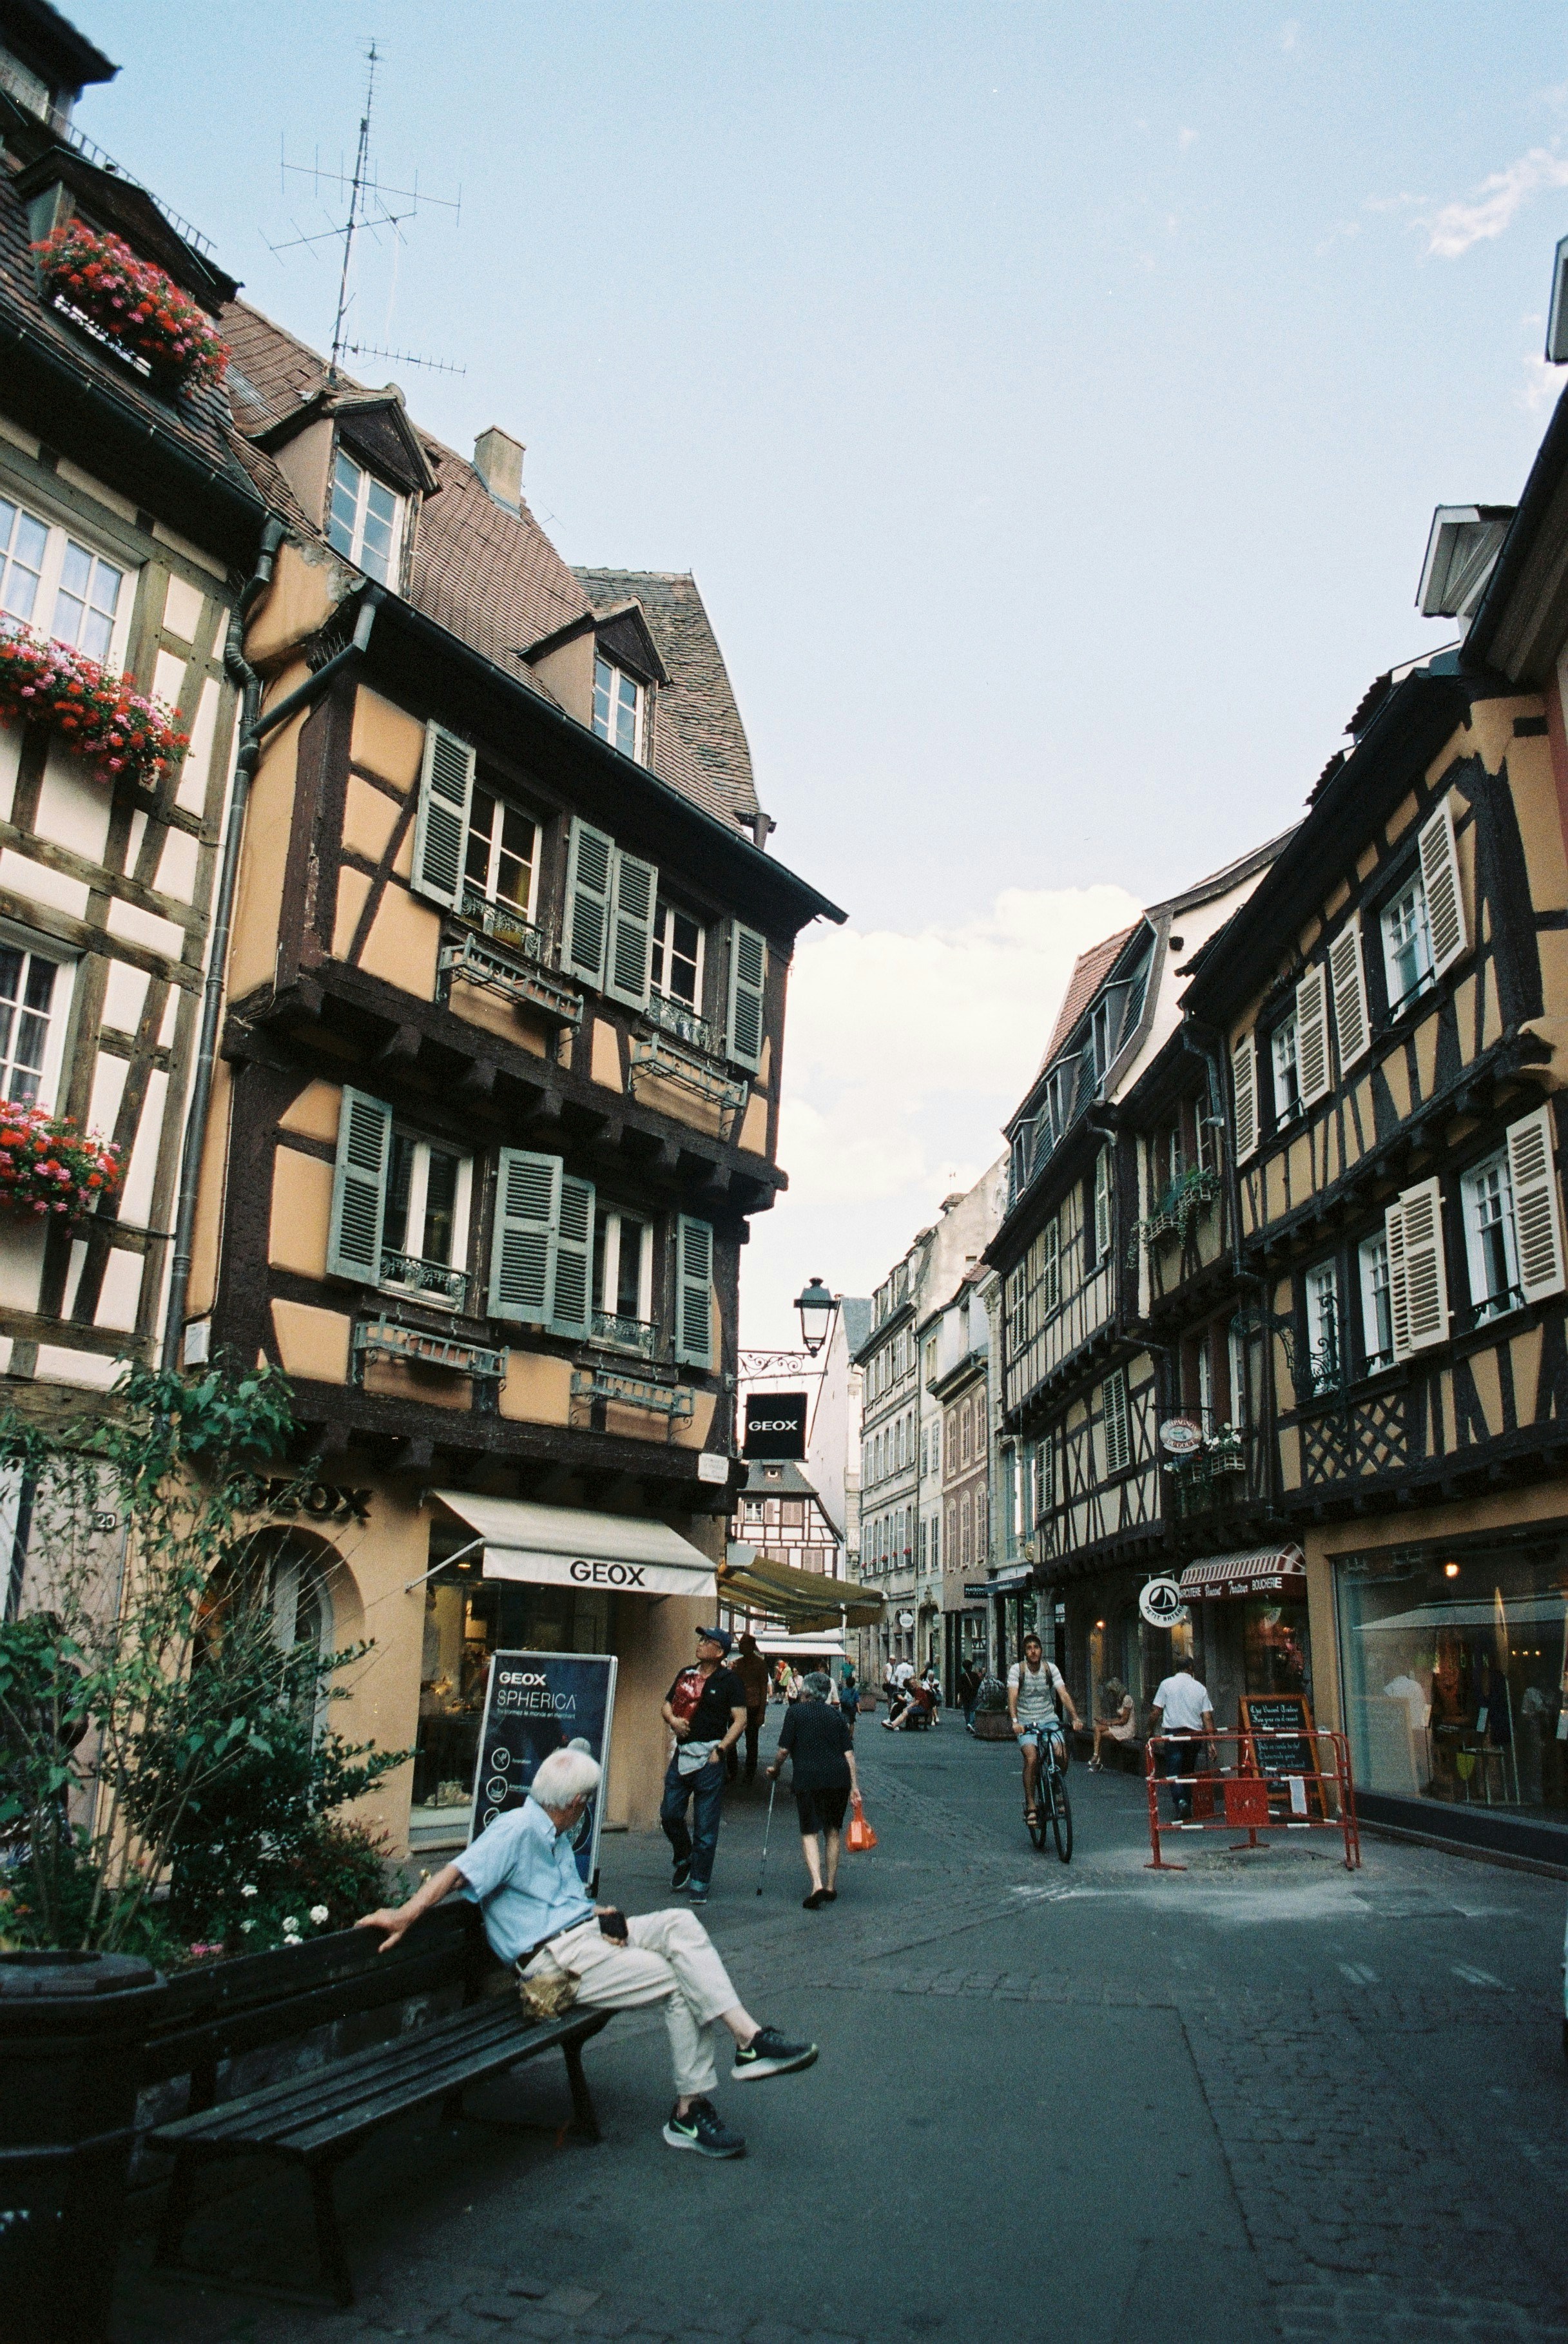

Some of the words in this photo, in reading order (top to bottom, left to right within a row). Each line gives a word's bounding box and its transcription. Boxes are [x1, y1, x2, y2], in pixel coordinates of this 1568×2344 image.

[748, 1420, 798, 1431] GEOX
[97, 1513, 115, 1528] 20
[570, 1560, 646, 1586] GEOX
[1252, 1576, 1282, 1591] BOUCHERIE
[1145, 1605, 1161, 1620] PETIT
[1163, 1605, 1185, 1622] BATEAU
[499, 1671, 547, 1686] GEOX
[497, 1689, 576, 1710] SPHERICA
